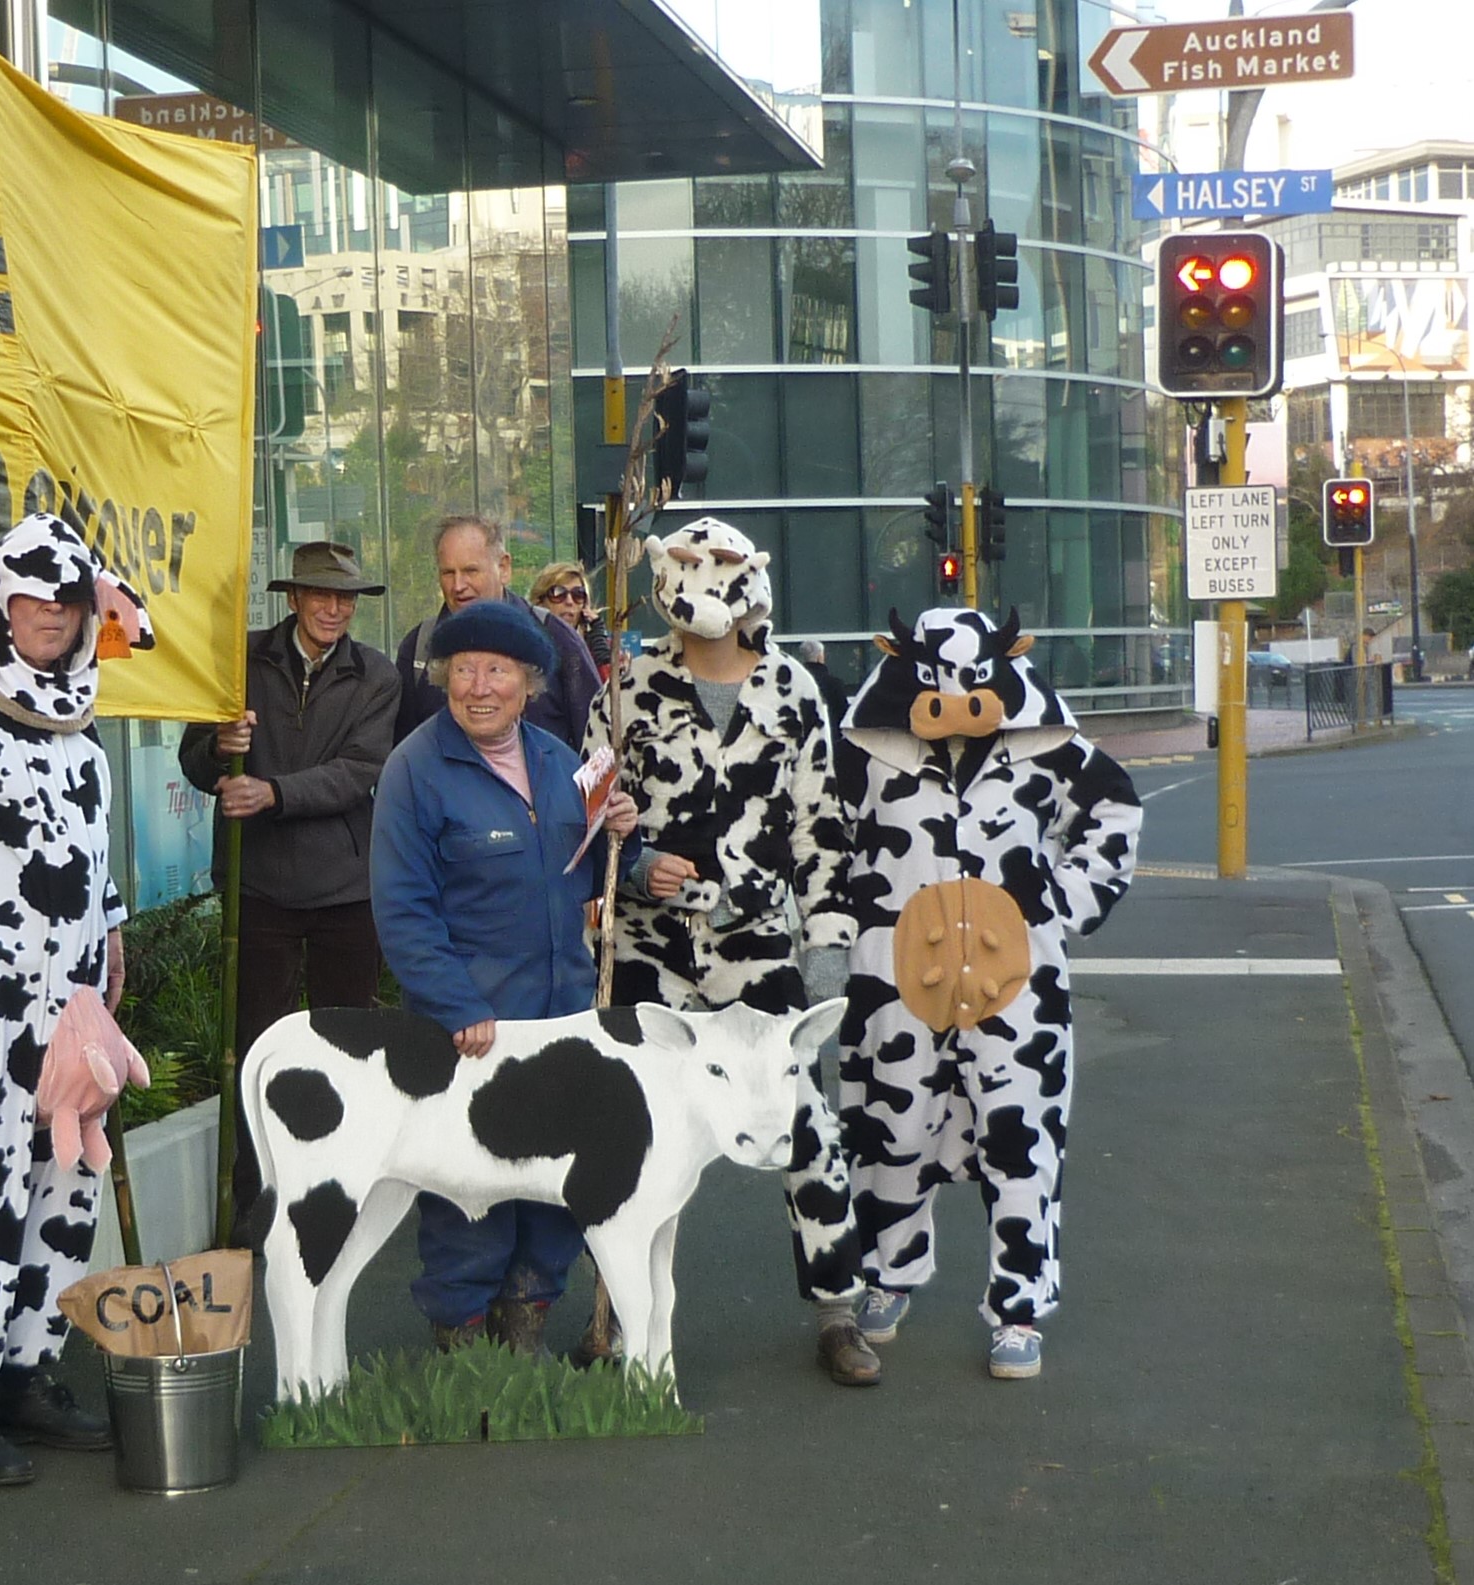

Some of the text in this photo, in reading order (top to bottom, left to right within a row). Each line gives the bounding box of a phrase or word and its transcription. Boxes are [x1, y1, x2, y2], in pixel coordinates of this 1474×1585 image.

[1183, 23, 1321, 53] Auckland
[1163, 51, 1341, 82] Fish Market
[1177, 176, 1317, 209] HALSEY ST
[1190, 491, 1269, 509] LEFT LANE
[1191, 513, 1270, 530] LEFT TURN
[1212, 535, 1250, 550] ONLY
[1204, 556, 1258, 572] EXCEPT
[1208, 578, 1255, 593] BUSES
[95, 1271, 232, 1332] COAL
